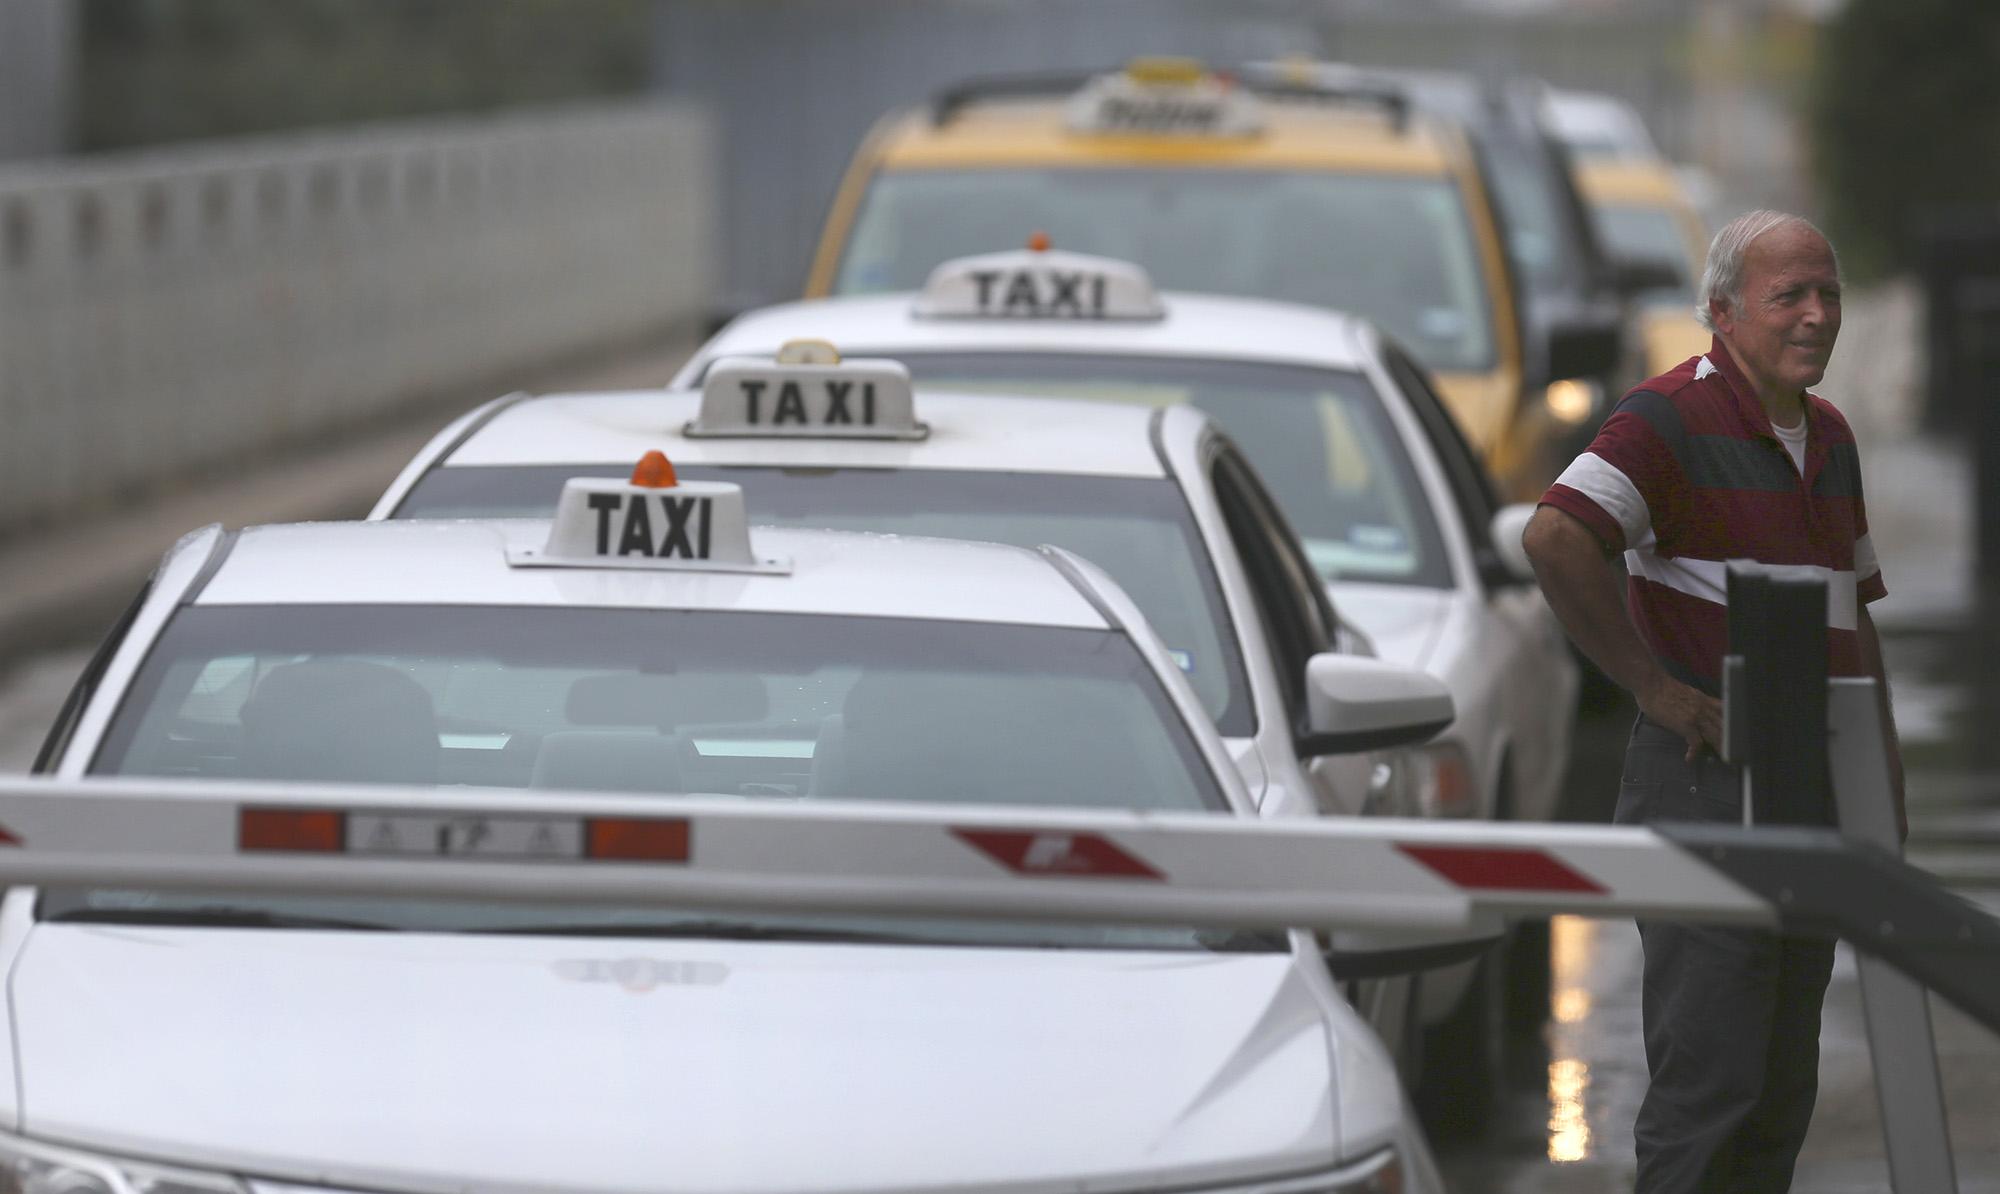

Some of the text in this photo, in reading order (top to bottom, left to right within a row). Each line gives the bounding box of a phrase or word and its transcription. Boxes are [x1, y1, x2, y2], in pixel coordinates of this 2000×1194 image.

[969, 271, 1106, 316] TAXI
[740, 380, 876, 425] TAXI
[587, 493, 712, 560] TAXI
